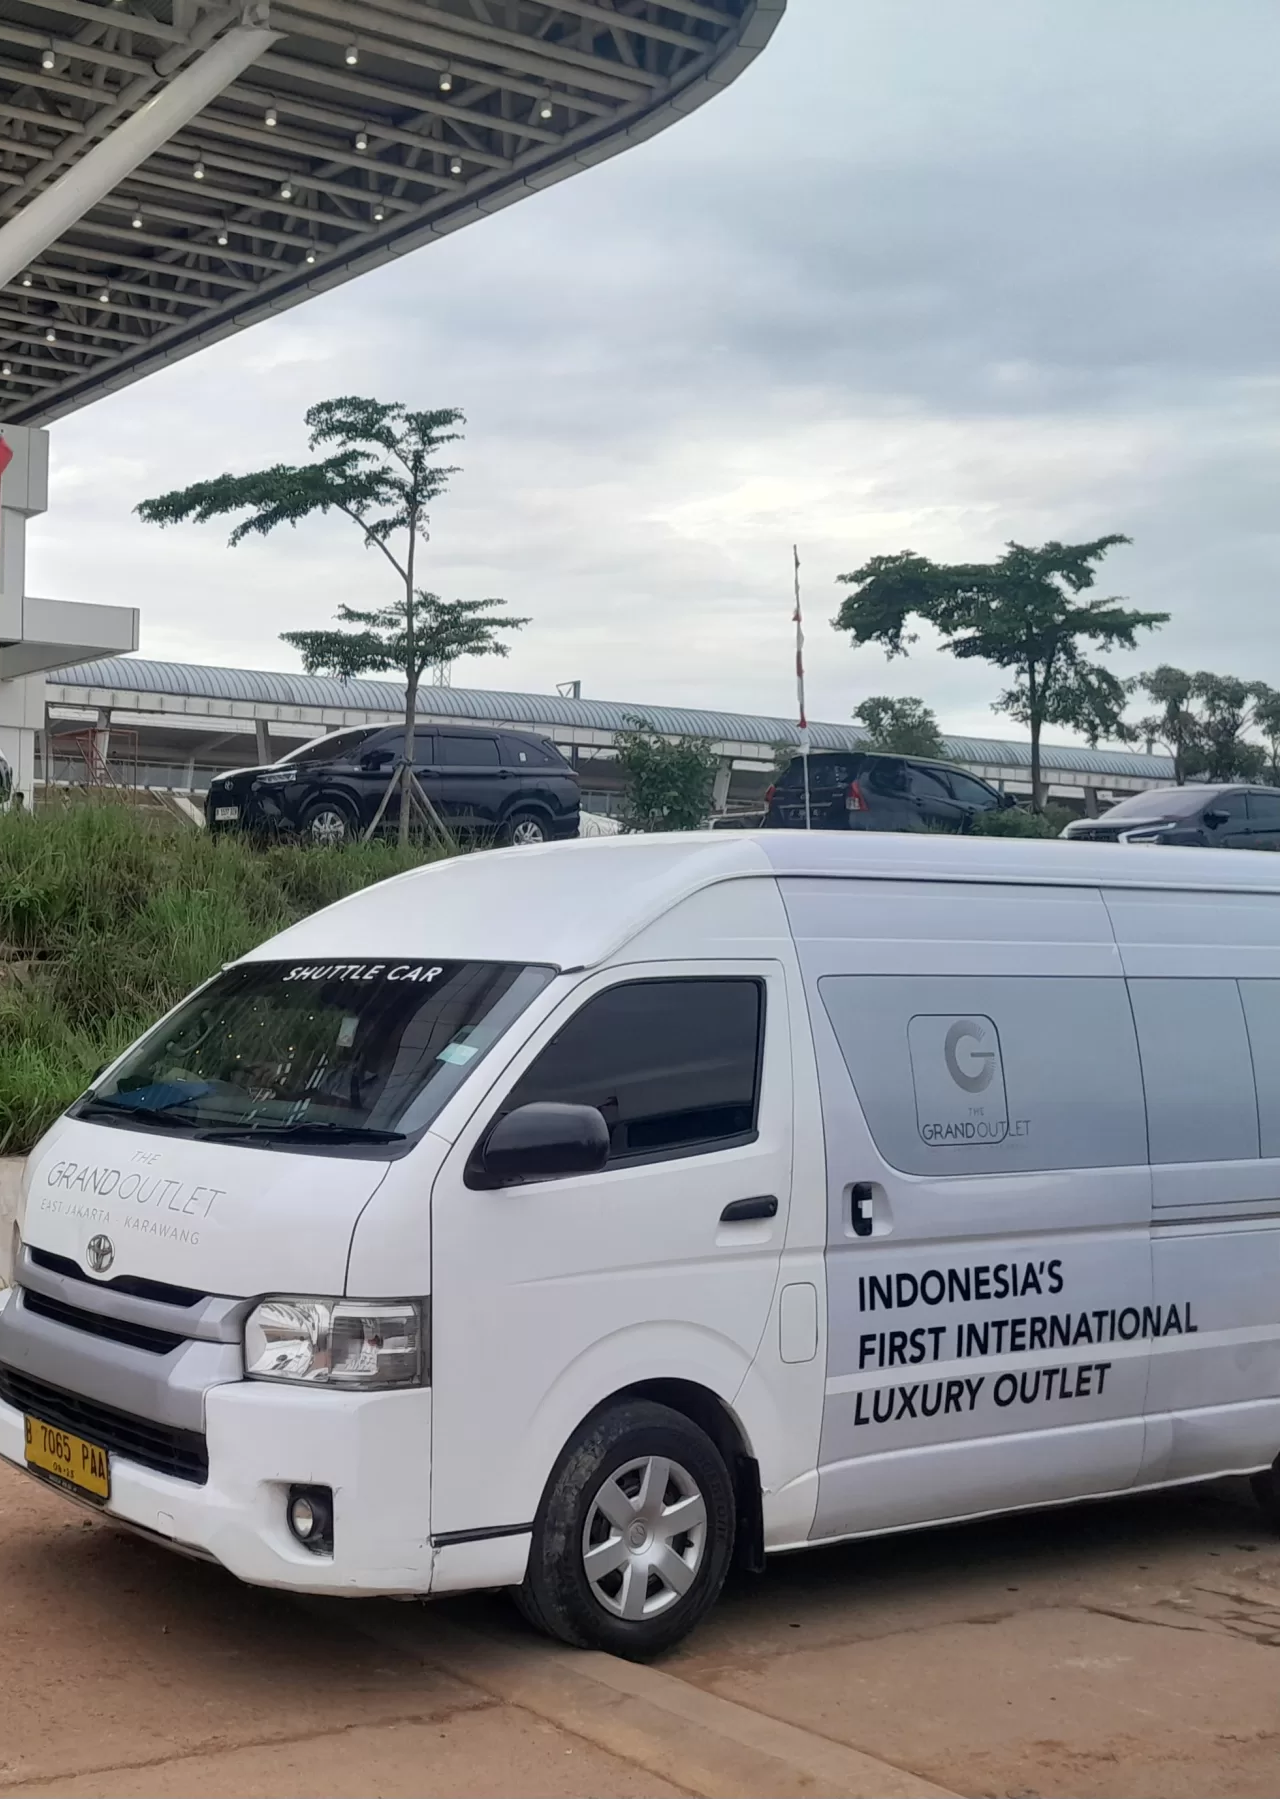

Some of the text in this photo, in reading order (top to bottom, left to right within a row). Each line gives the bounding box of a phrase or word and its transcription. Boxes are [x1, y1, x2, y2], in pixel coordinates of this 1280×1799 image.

[282, 965, 443, 983] SHUTTLE CAR
[967, 1107, 985, 1116] THE
[130, 1150, 162, 1165] THE
[40, 1198, 63, 1213] EAST
[65, 1203, 110, 1224] JAKARTA
[123, 1215, 200, 1245] KARAWANG
[858, 1259, 1064, 1312] INDONESIA'S
[858, 1302, 1198, 1370] FIRST INTERNATIONAL
[853, 1363, 1112, 1426] LUXURY OUTLET
[26, 1418, 106, 1480] B 7065 PAA
